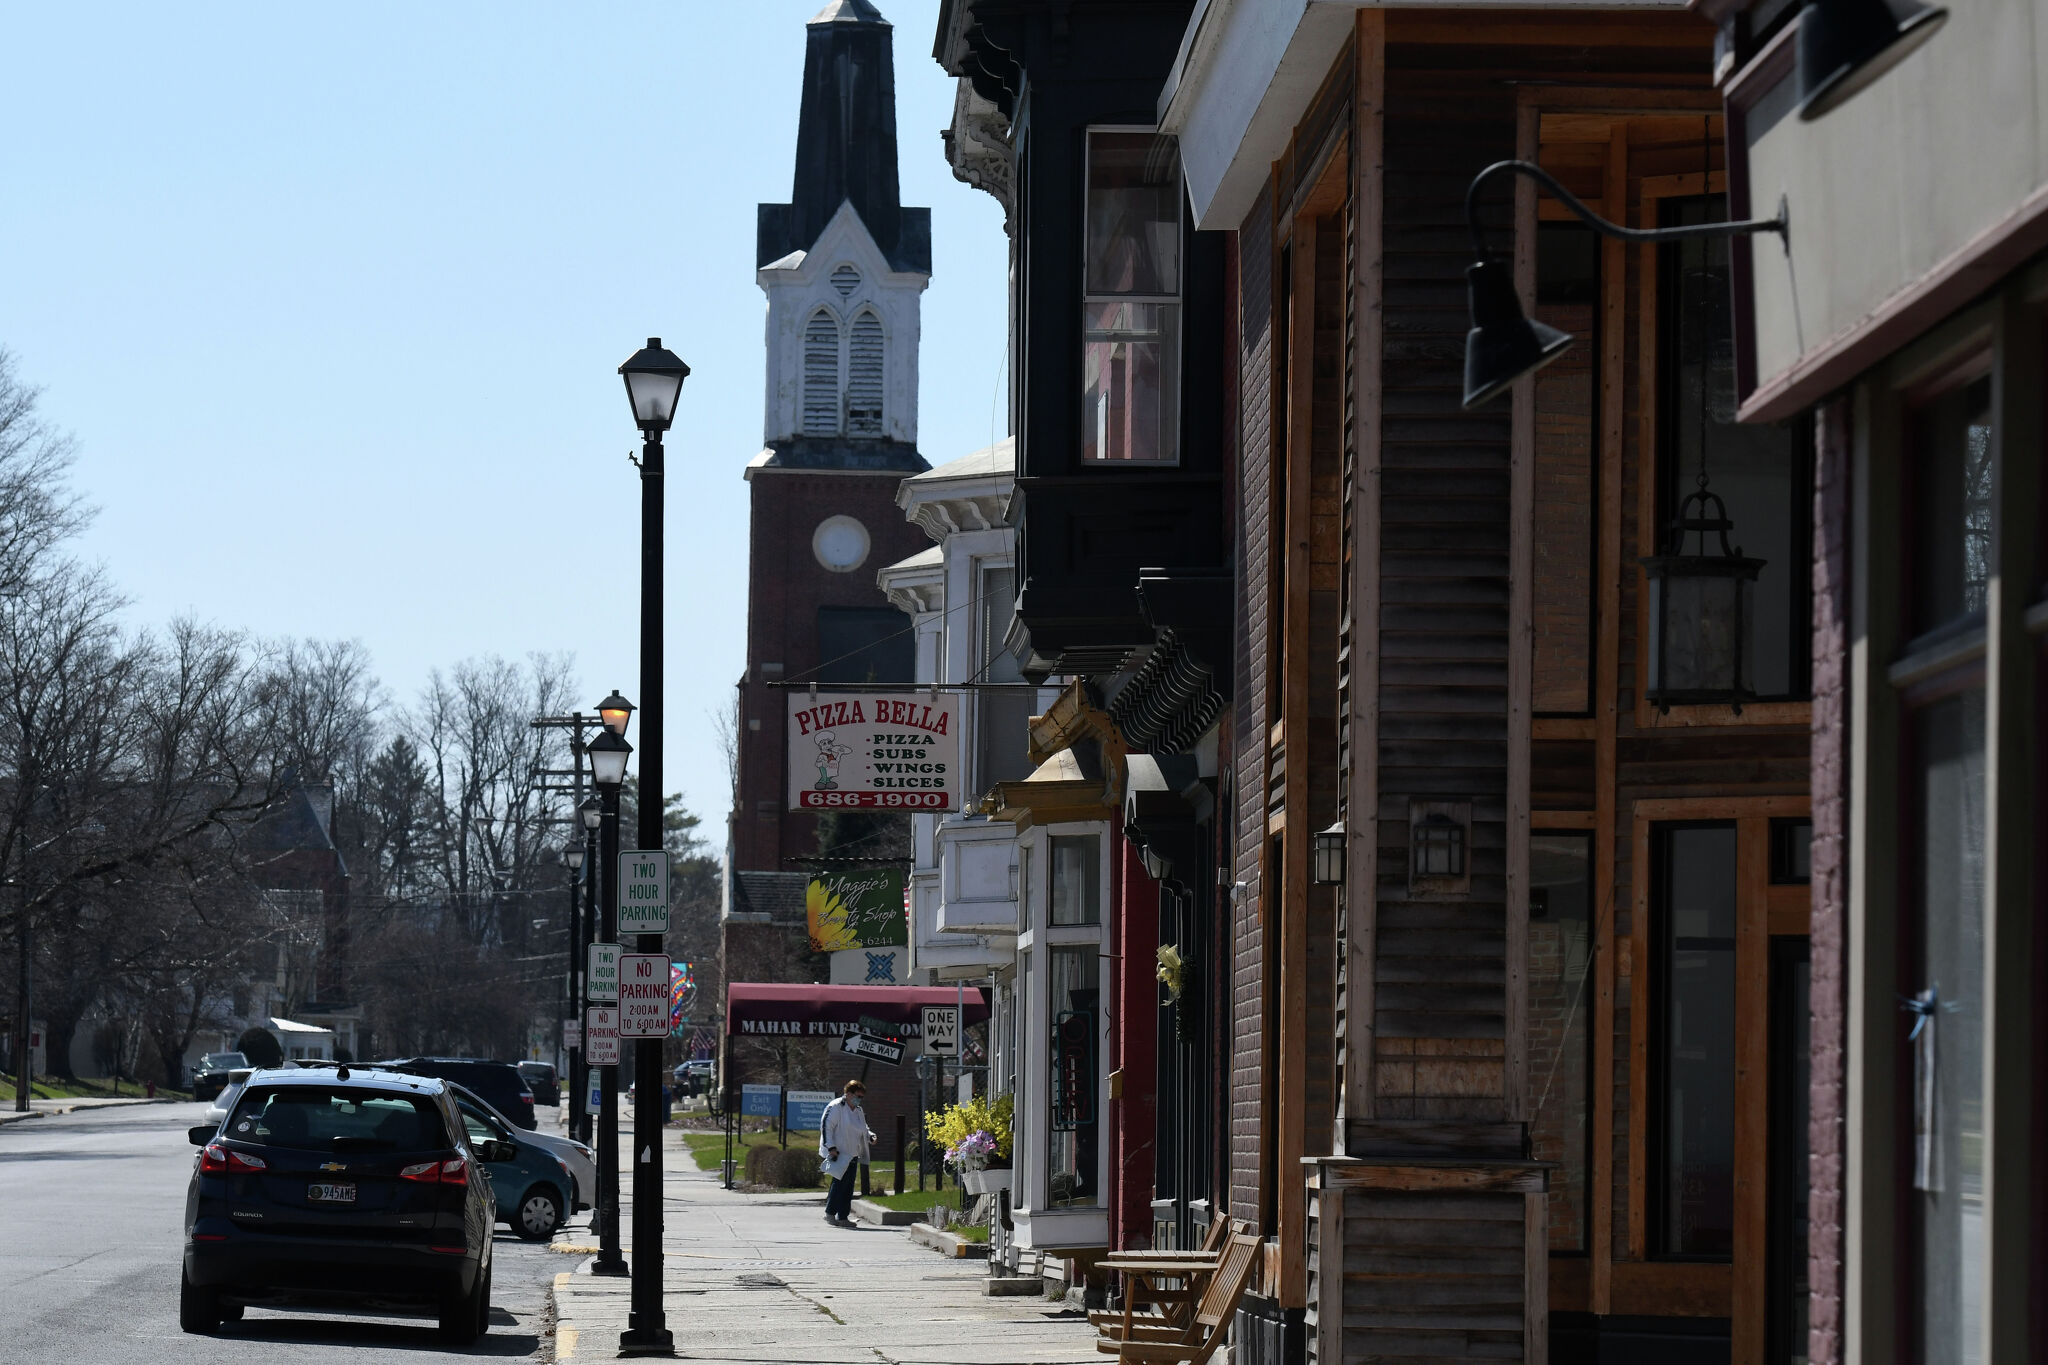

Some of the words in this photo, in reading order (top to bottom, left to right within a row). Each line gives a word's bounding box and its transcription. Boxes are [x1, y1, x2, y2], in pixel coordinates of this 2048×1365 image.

[795, 700, 866, 736] PIZZA
[875, 699, 949, 736] BELLA
[873, 734, 936, 745] PIZZA
[873, 748, 927, 759] SUBS
[873, 763, 946, 774] WINGS
[873, 777, 945, 788] SLICES
[807, 793, 942, 806] 686-1900
[632, 863, 656, 878] TWO
[629, 884, 659, 900] HOUR
[820, 872, 889, 908] Maggie's
[621, 905, 667, 921] PARKING
[862, 903, 897, 933] Shop
[598, 952, 614, 964] TWO
[595, 967, 615, 978] HOUR
[636, 962, 652, 977] NO
[621, 983, 668, 999] PARKING
[598, 1012, 609, 1024] NO
[623, 1018, 632, 1029] TO
[928, 1012, 954, 1023] ONE
[589, 1027, 618, 1038] PARKING
[741, 1020, 801, 1034] MAHAR
[808, 1021, 880, 1036] FUNERA
[927, 1025, 954, 1036] WAY
[858, 1040, 876, 1053] ONE
[877, 1046, 897, 1057] WAY
[752, 1095, 770, 1104] Exit
[750, 1104, 772, 1114] Only
